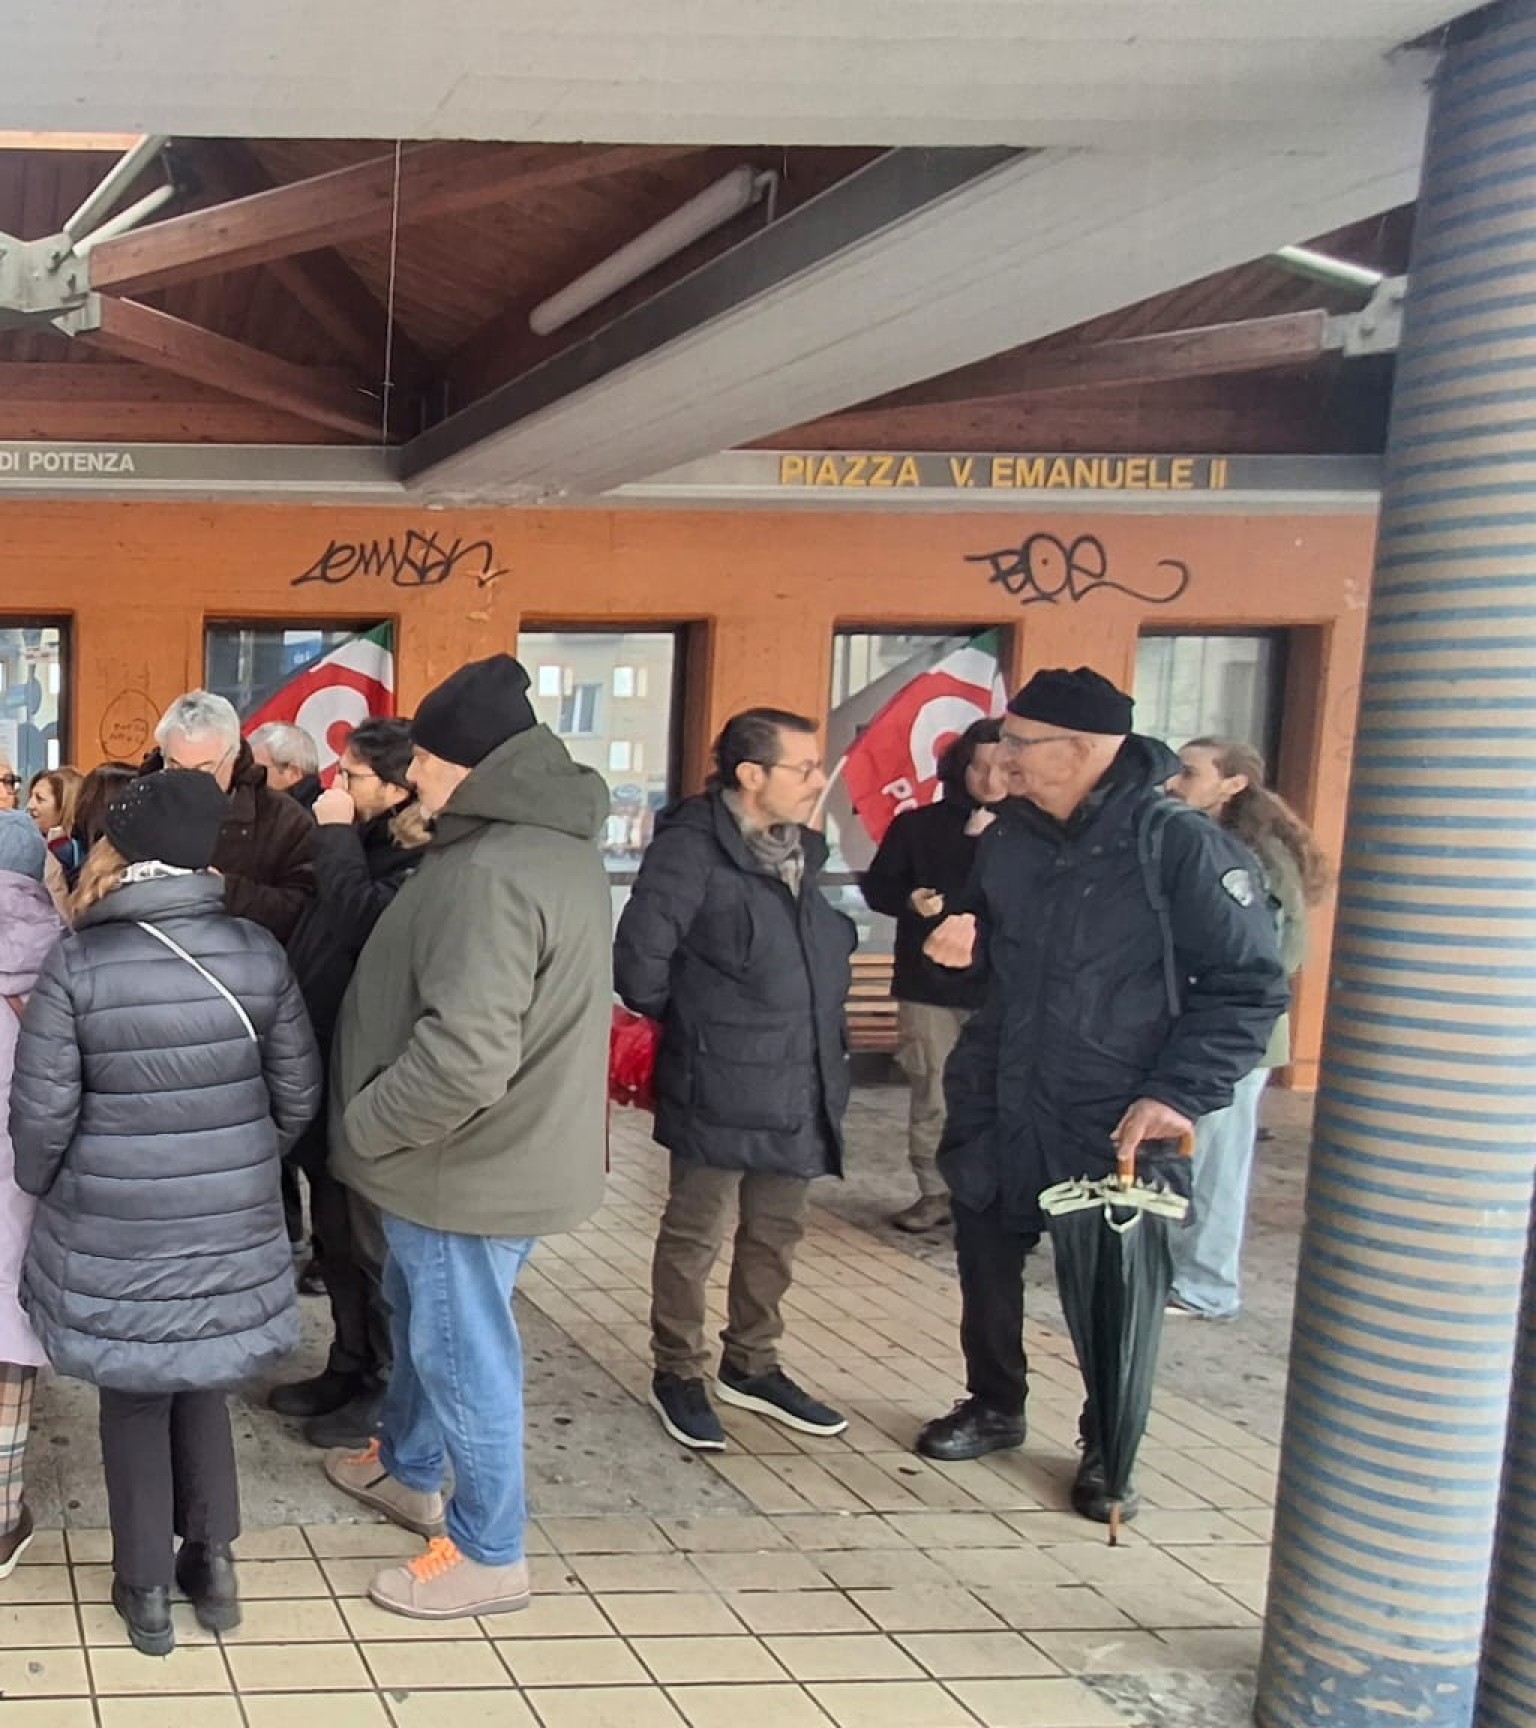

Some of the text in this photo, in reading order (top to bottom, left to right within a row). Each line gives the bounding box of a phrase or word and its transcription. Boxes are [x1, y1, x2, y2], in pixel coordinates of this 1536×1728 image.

[28, 452, 136, 472] POTENZA
[780, 456, 1228, 489] PIAZZA V. EMANUELE II
